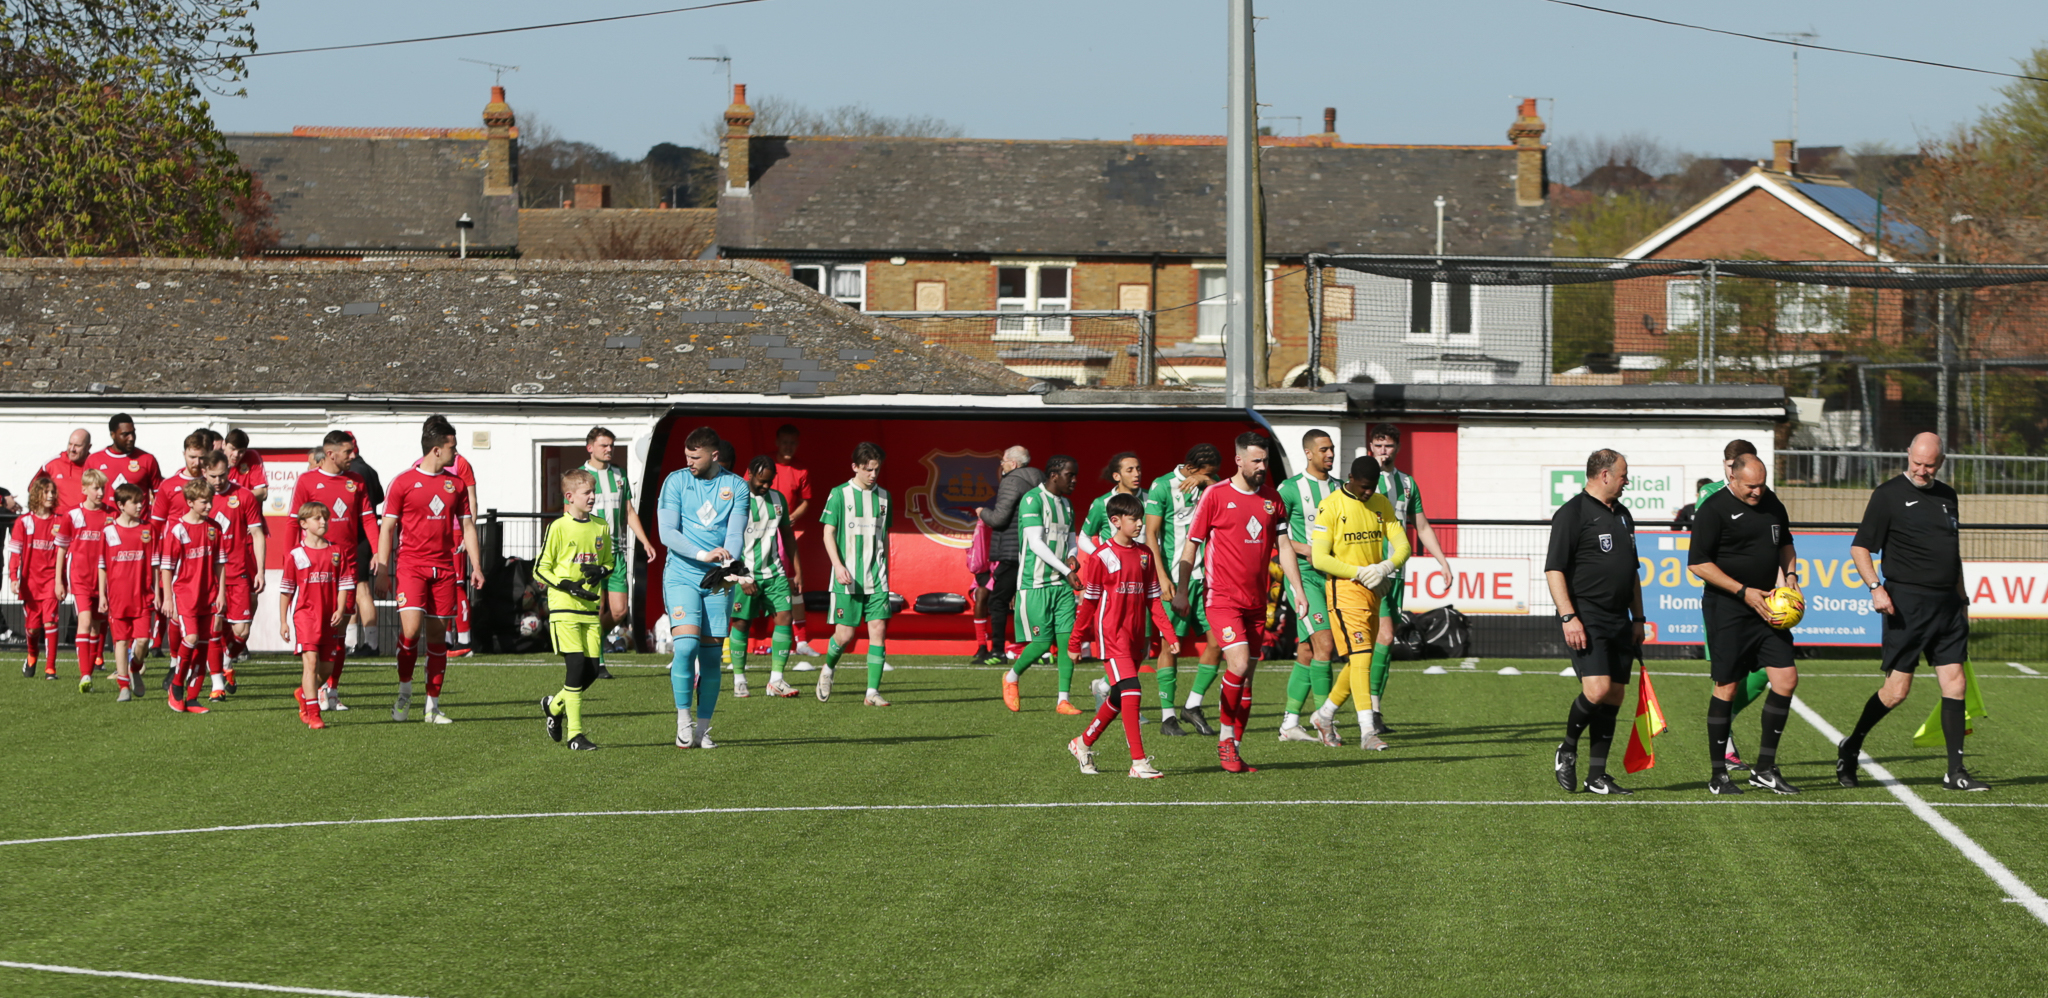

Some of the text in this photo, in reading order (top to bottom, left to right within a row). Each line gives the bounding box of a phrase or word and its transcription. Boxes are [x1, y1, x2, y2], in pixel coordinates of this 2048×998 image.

[265, 471, 299, 481] FICIA
[1625, 476, 1670, 491] dical
[1623, 497, 1664, 509] oom
[1404, 571, 1514, 599] HOME
[1659, 594, 1703, 610] Hom
[1812, 595, 1876, 616] Storage
[1668, 624, 1699, 634] 01227
[1790, 626, 1866, 636] ce-saver.co.uk
